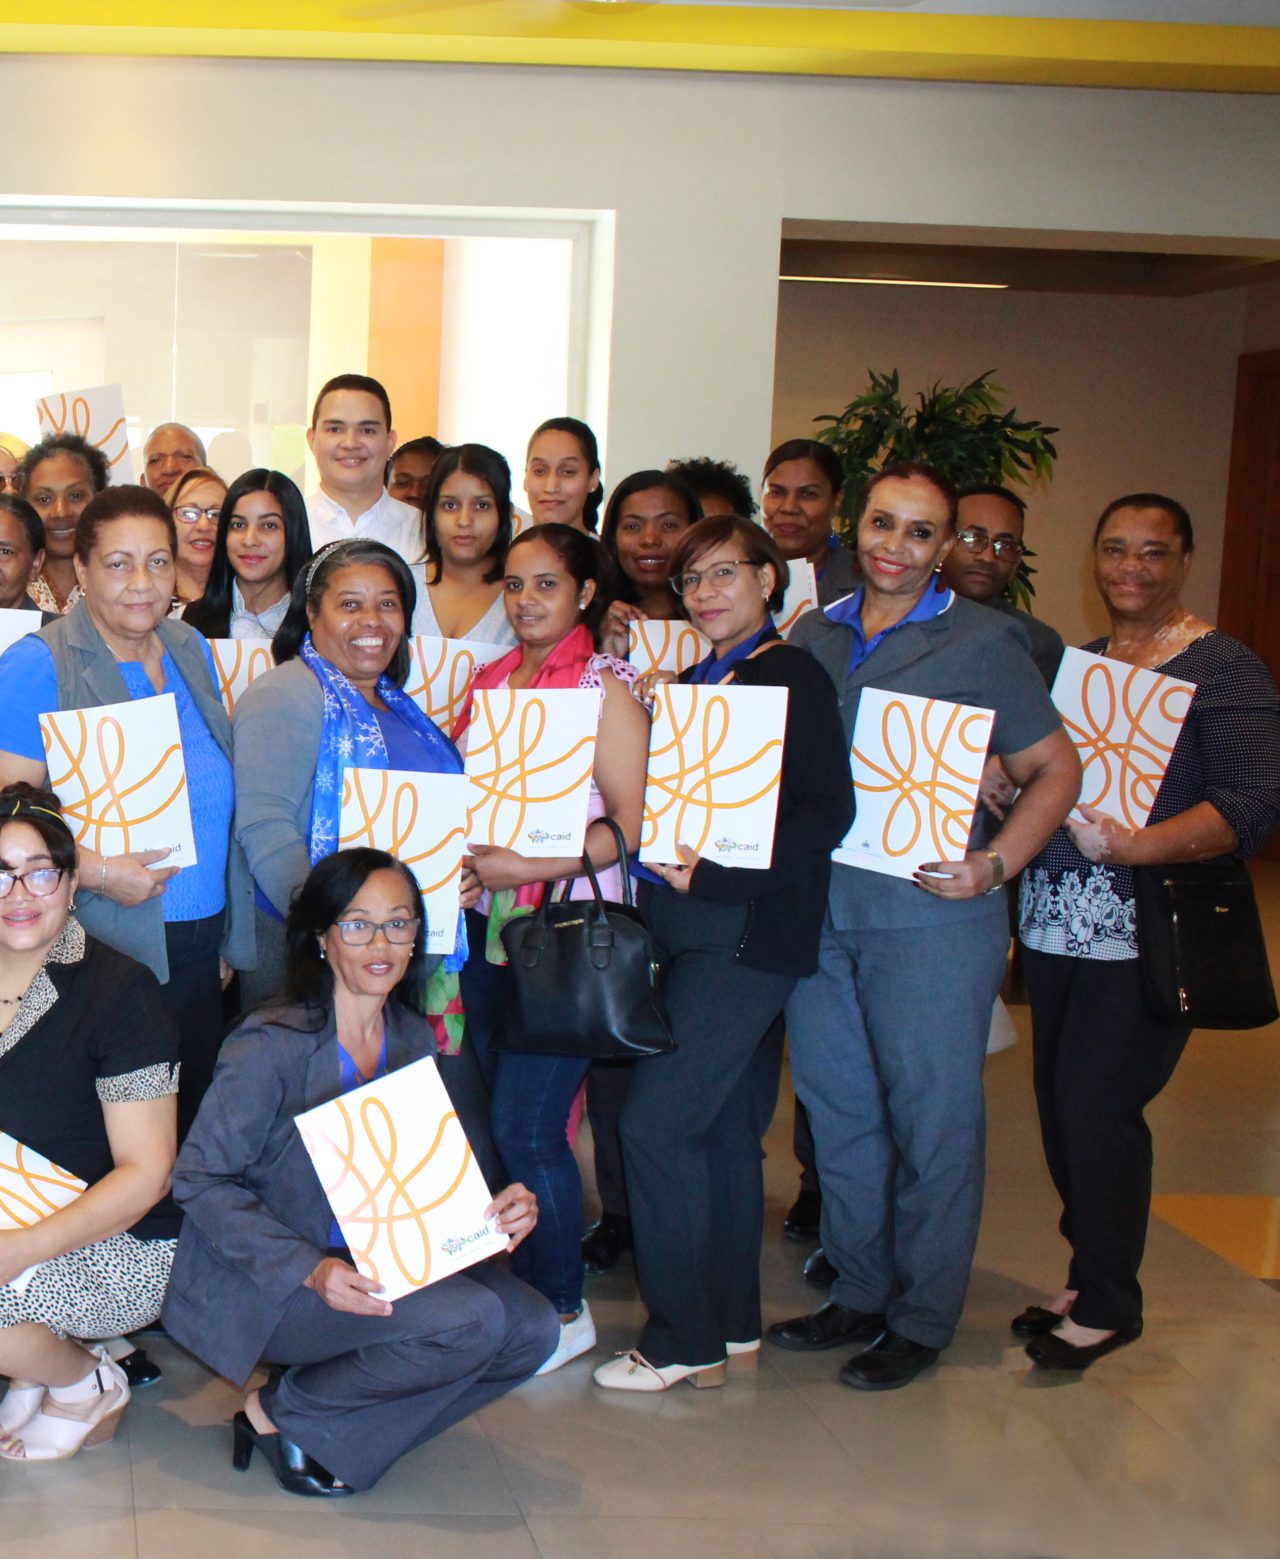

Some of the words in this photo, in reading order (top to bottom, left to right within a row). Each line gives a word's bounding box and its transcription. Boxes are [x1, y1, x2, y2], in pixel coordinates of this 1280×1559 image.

[550, 831, 572, 841] caid
[738, 841, 759, 851] caid
[466, 1224, 490, 1243] caid
